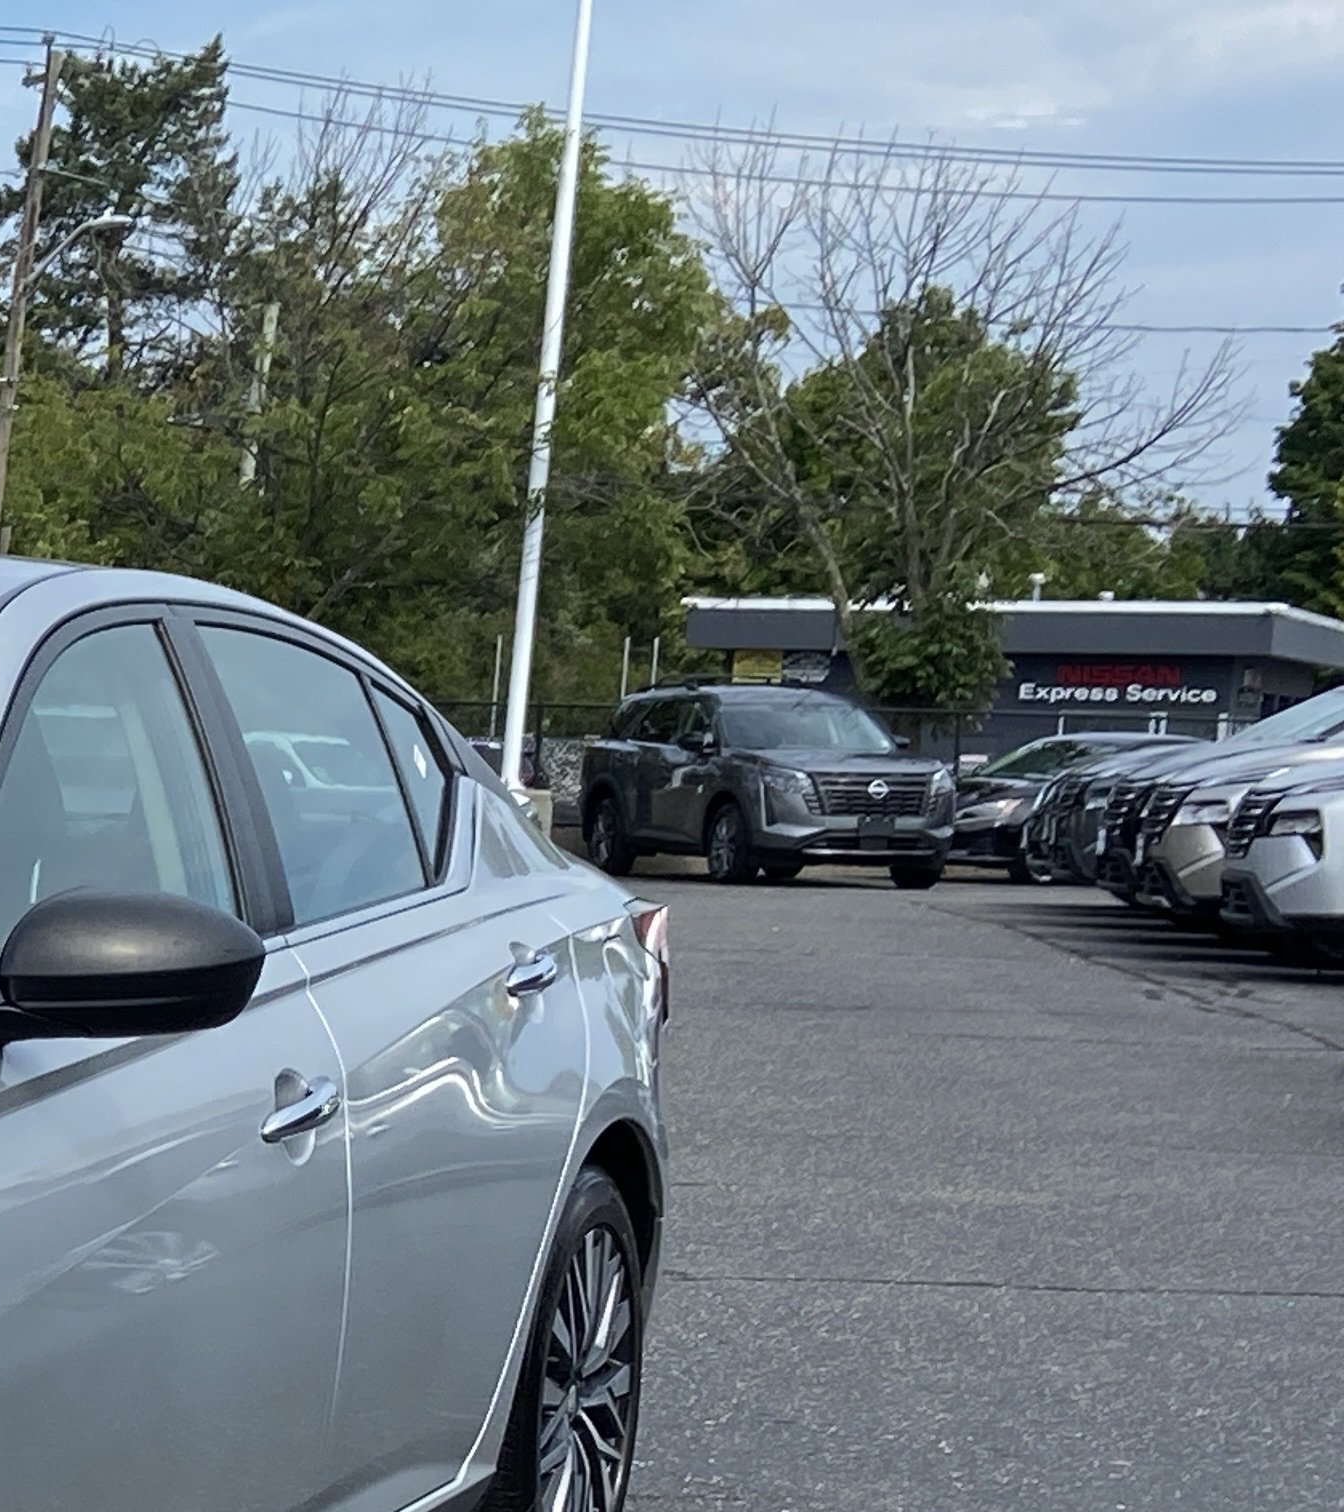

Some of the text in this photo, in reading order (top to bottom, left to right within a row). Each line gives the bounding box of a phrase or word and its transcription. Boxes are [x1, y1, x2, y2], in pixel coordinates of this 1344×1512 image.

[1057, 665, 1183, 684] NISSAN
[1019, 682, 1217, 704] Express Service
